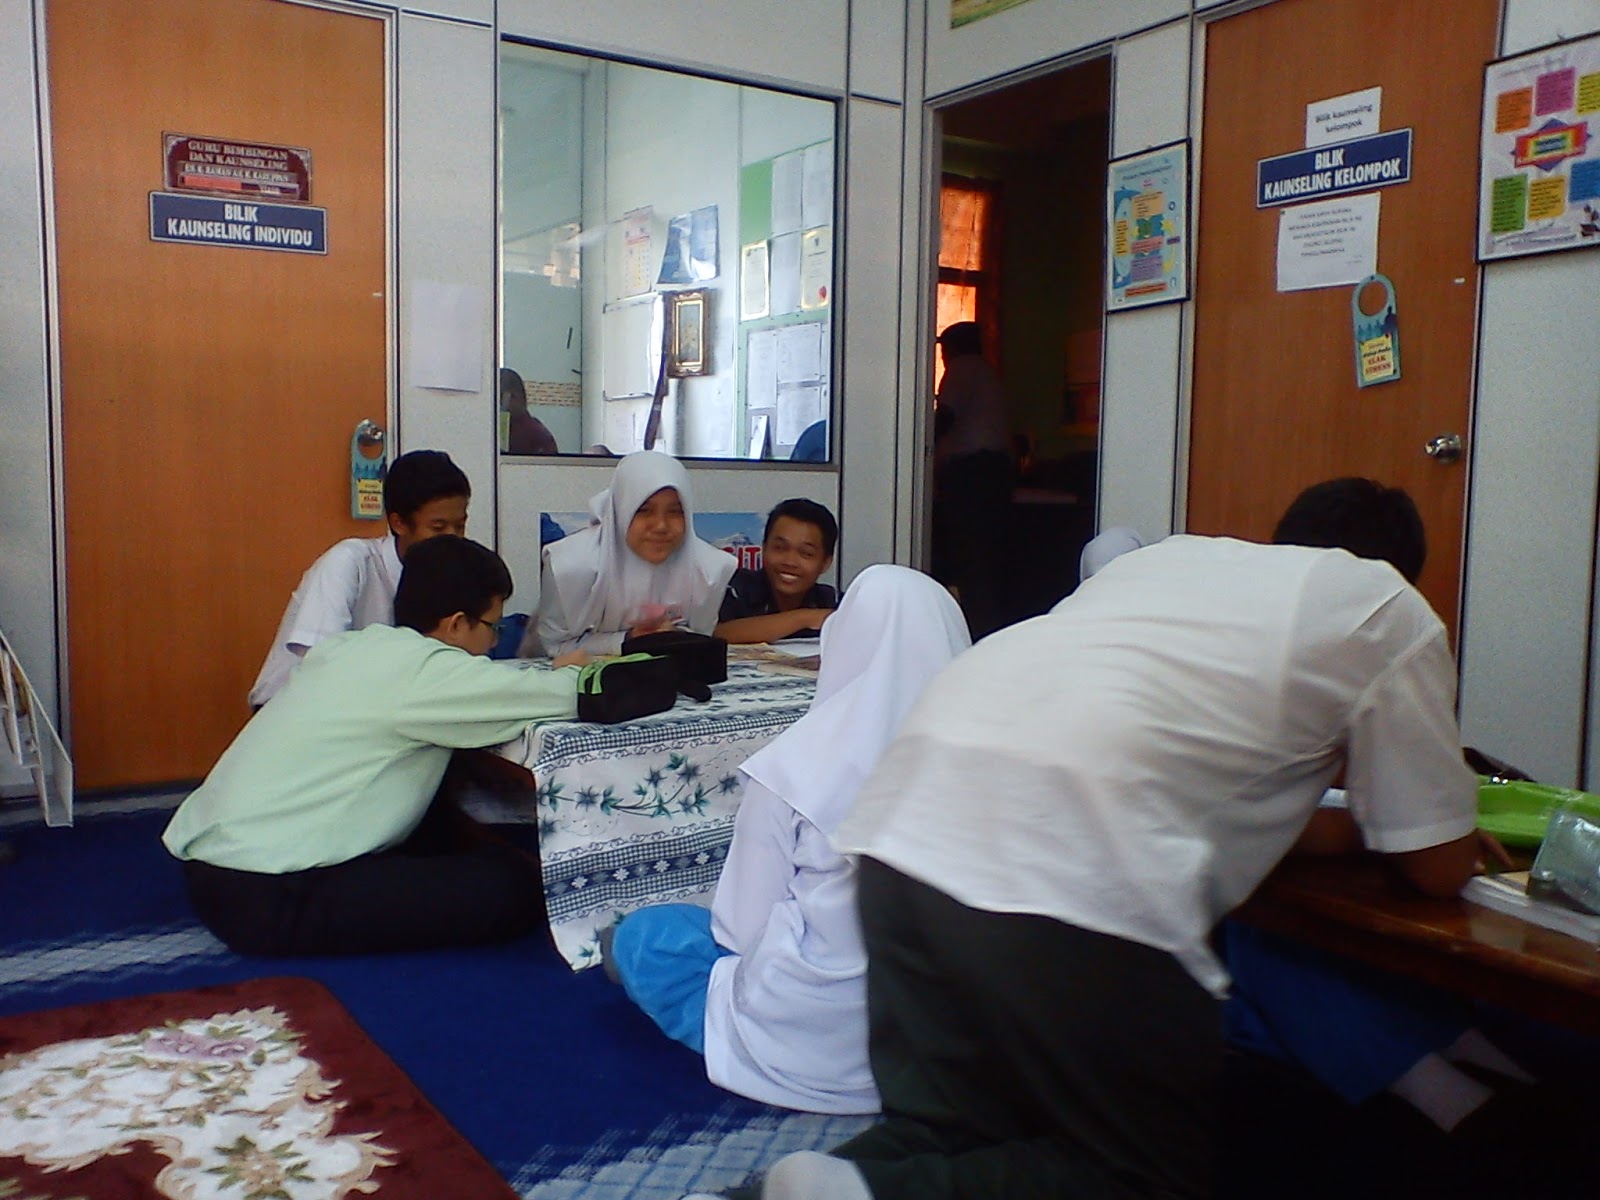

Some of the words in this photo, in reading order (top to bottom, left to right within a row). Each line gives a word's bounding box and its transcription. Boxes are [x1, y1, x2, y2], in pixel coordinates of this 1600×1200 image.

[189, 151, 214, 163] DAN
[1315, 148, 1345, 170] BILIK
[1264, 172, 1332, 200] KAUNSELING
[1335, 158, 1401, 187] KELOMPOK
[224, 203, 258, 222] BILIK
[167, 217, 251, 242] KAUNSELING
[254, 223, 312, 246] INDIVIDU
